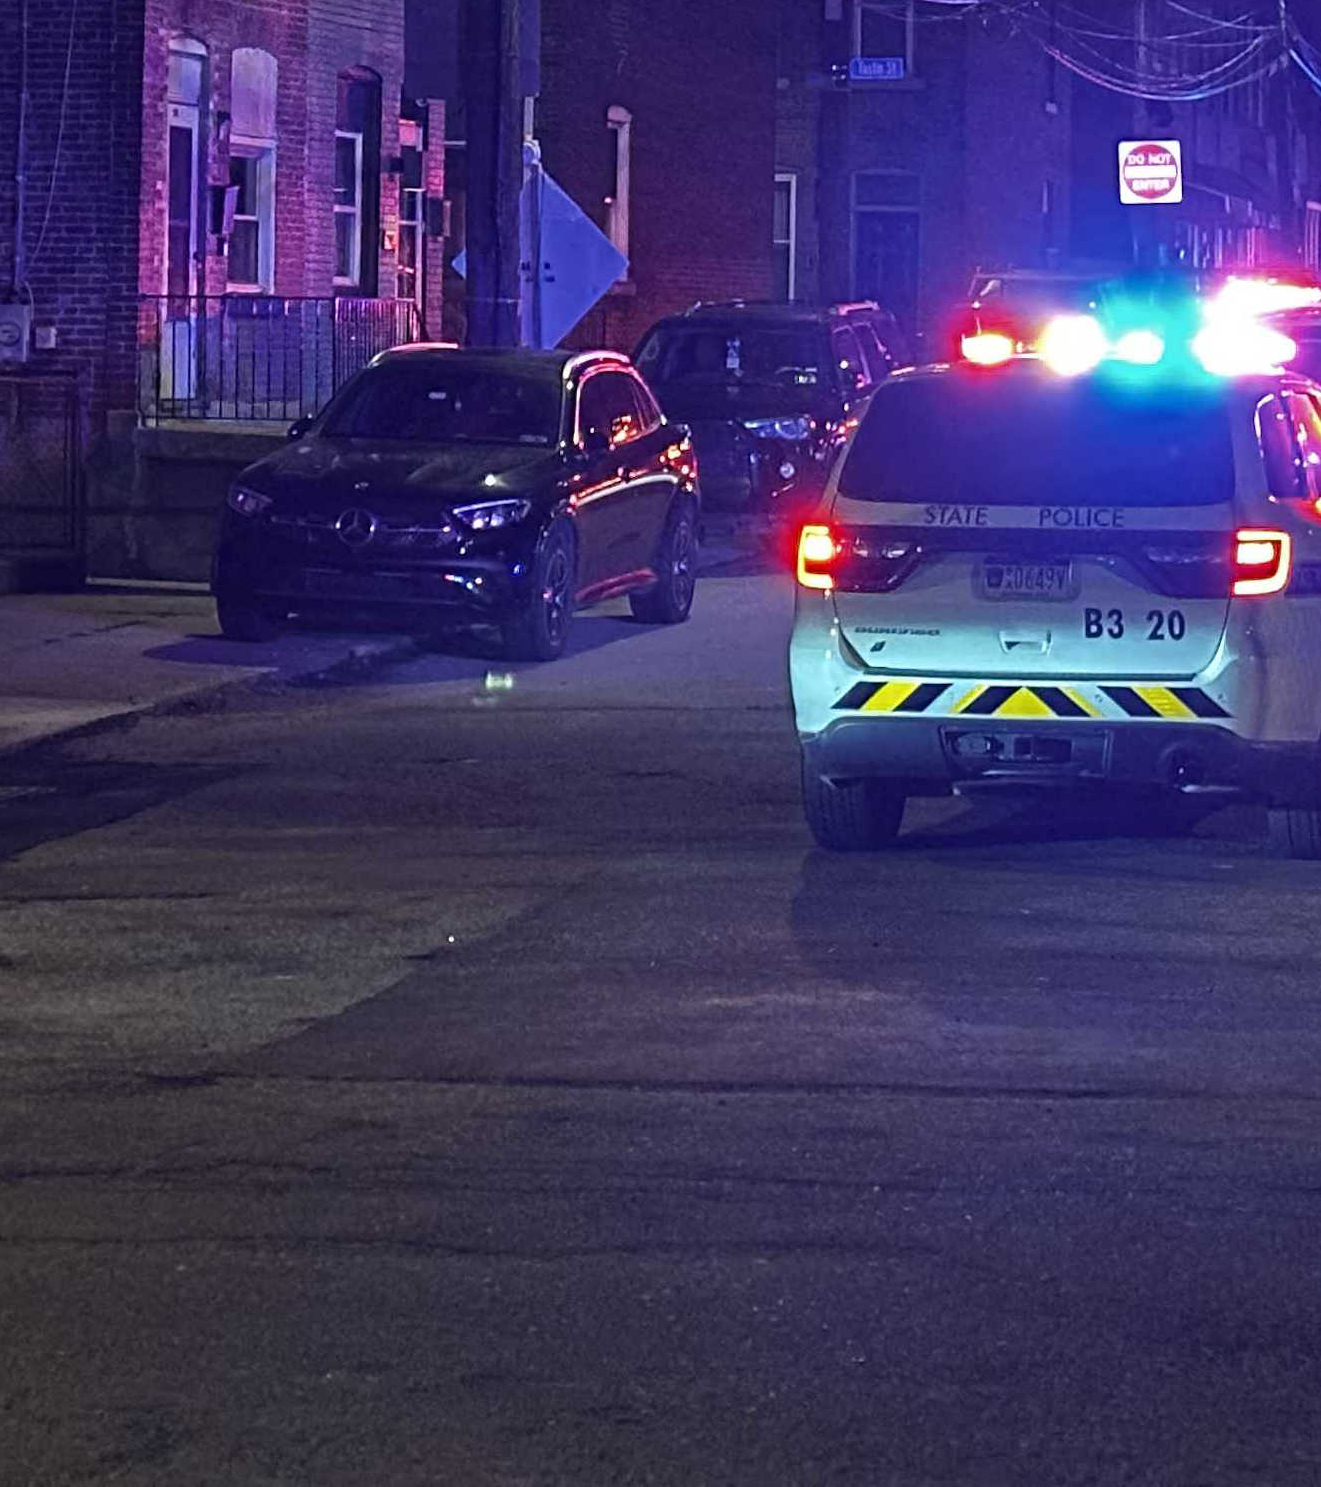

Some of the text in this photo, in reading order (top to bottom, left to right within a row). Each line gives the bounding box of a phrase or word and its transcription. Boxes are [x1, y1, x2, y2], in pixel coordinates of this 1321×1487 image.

[1127, 153, 1145, 165] DO
[923, 506, 1125, 528] STATE POLICE
[1083, 607, 1186, 642] B3 20
